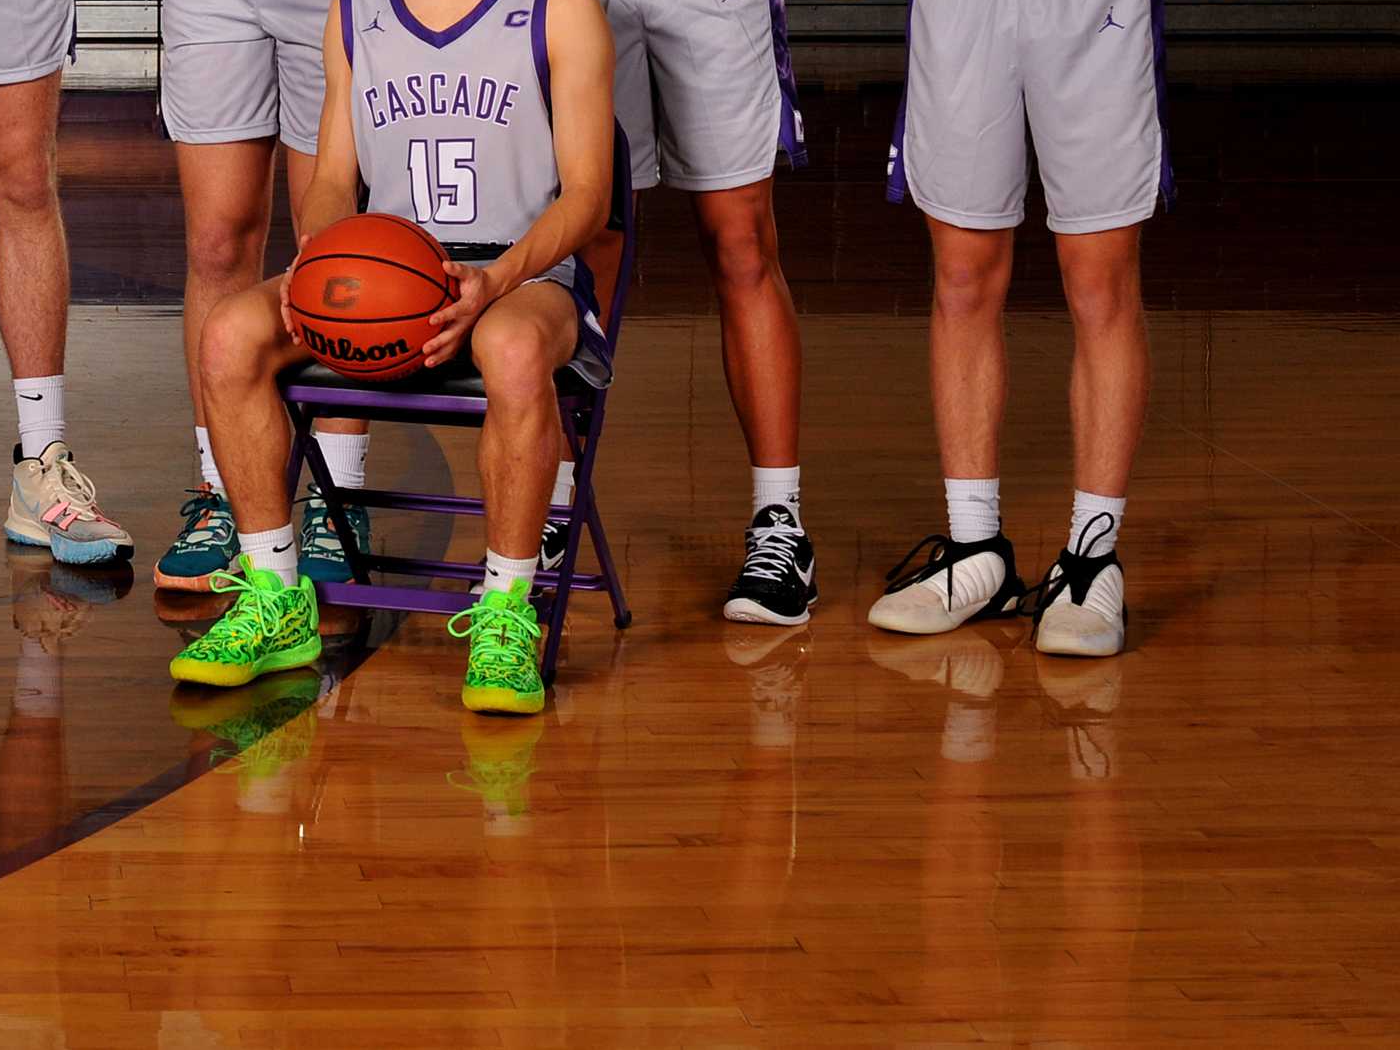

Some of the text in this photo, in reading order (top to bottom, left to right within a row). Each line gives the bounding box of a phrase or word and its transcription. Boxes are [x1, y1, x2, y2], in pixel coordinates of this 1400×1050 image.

[363, 72, 521, 130] CASCADE
[407, 137, 479, 225] 15
[301, 323, 412, 362] Wilson
